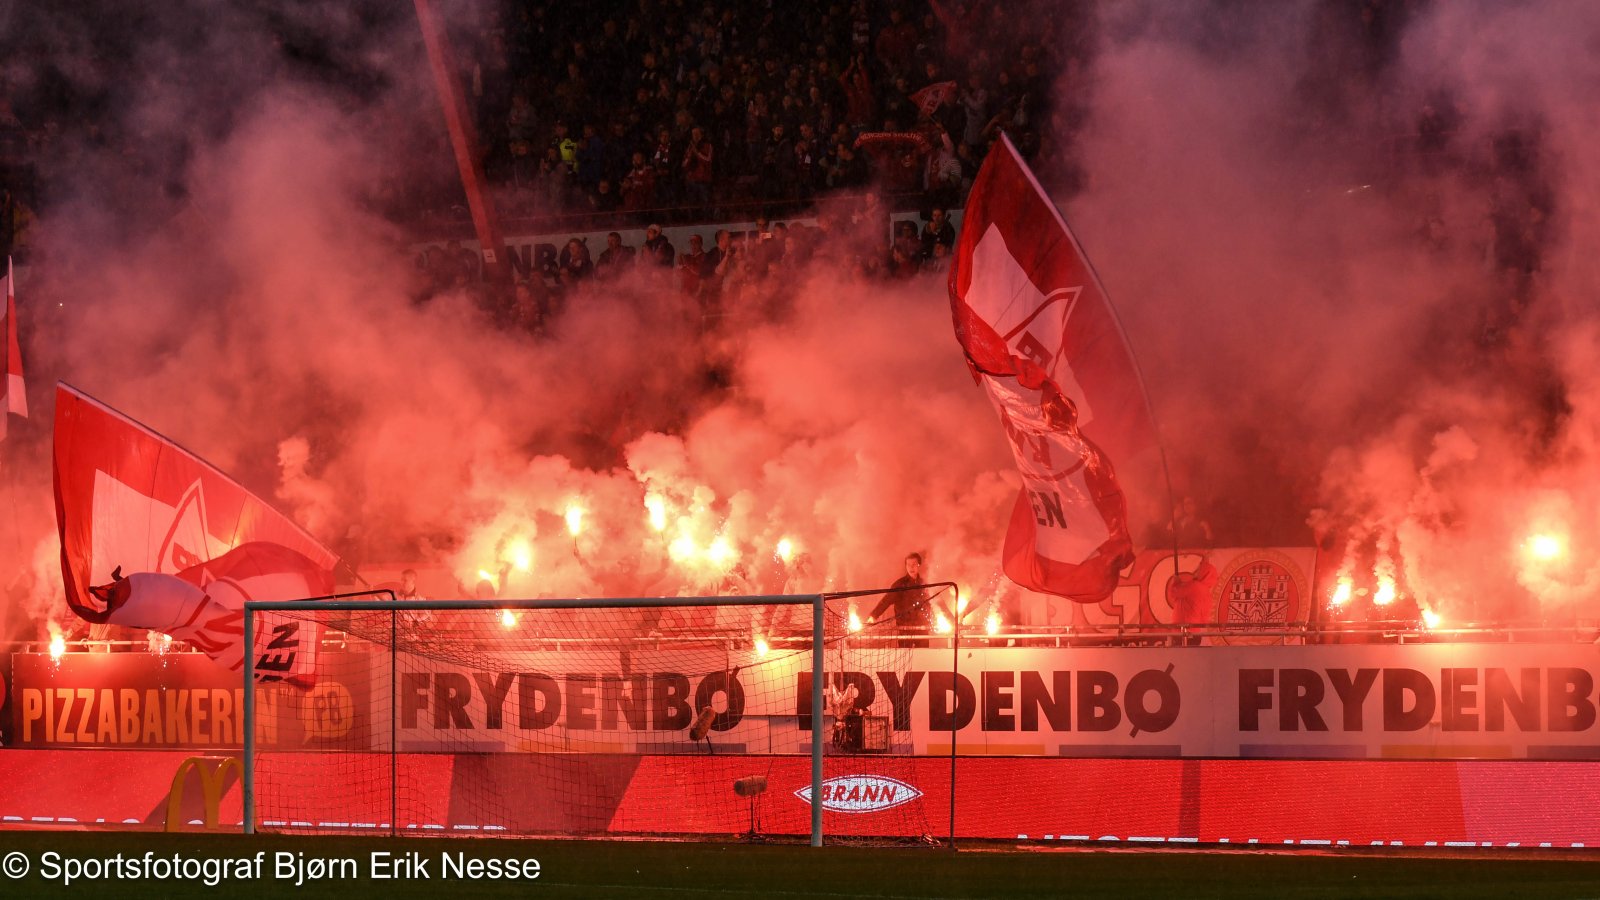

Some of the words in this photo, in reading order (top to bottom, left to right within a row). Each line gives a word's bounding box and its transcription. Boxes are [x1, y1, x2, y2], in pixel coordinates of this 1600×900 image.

[401, 666, 746, 732] FRYDENBØ
[1239, 668, 1600, 732] FRYDENB
[821, 785, 898, 802] BRANN
